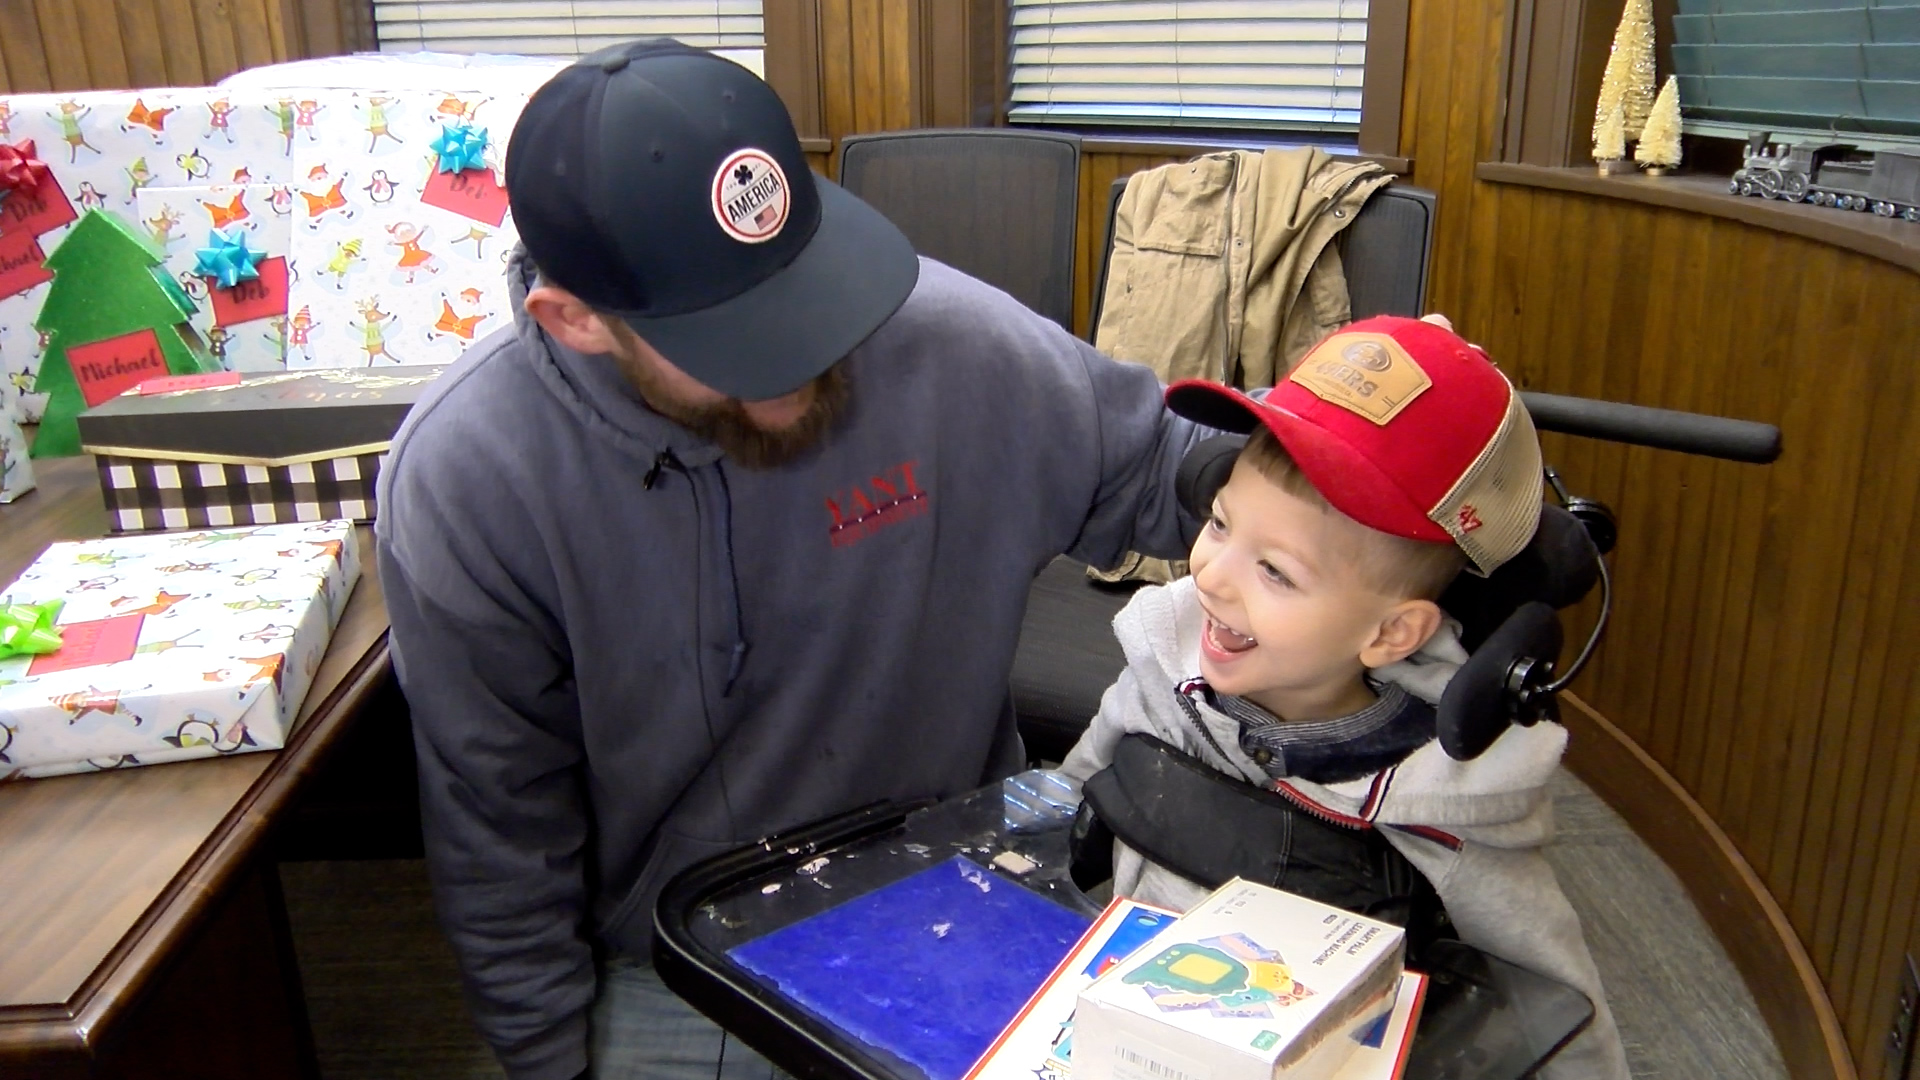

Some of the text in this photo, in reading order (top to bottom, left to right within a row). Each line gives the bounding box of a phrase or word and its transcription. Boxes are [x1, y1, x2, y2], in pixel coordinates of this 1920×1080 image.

[727, 172, 780, 223] AMERICA
[79, 348, 161, 384] Michael
[1336, 922, 1366, 944] LEARNING
[1359, 926, 1381, 944] SMART
[1312, 942, 1342, 966] MACHINE
[1346, 941, 1366, 956] PALM
